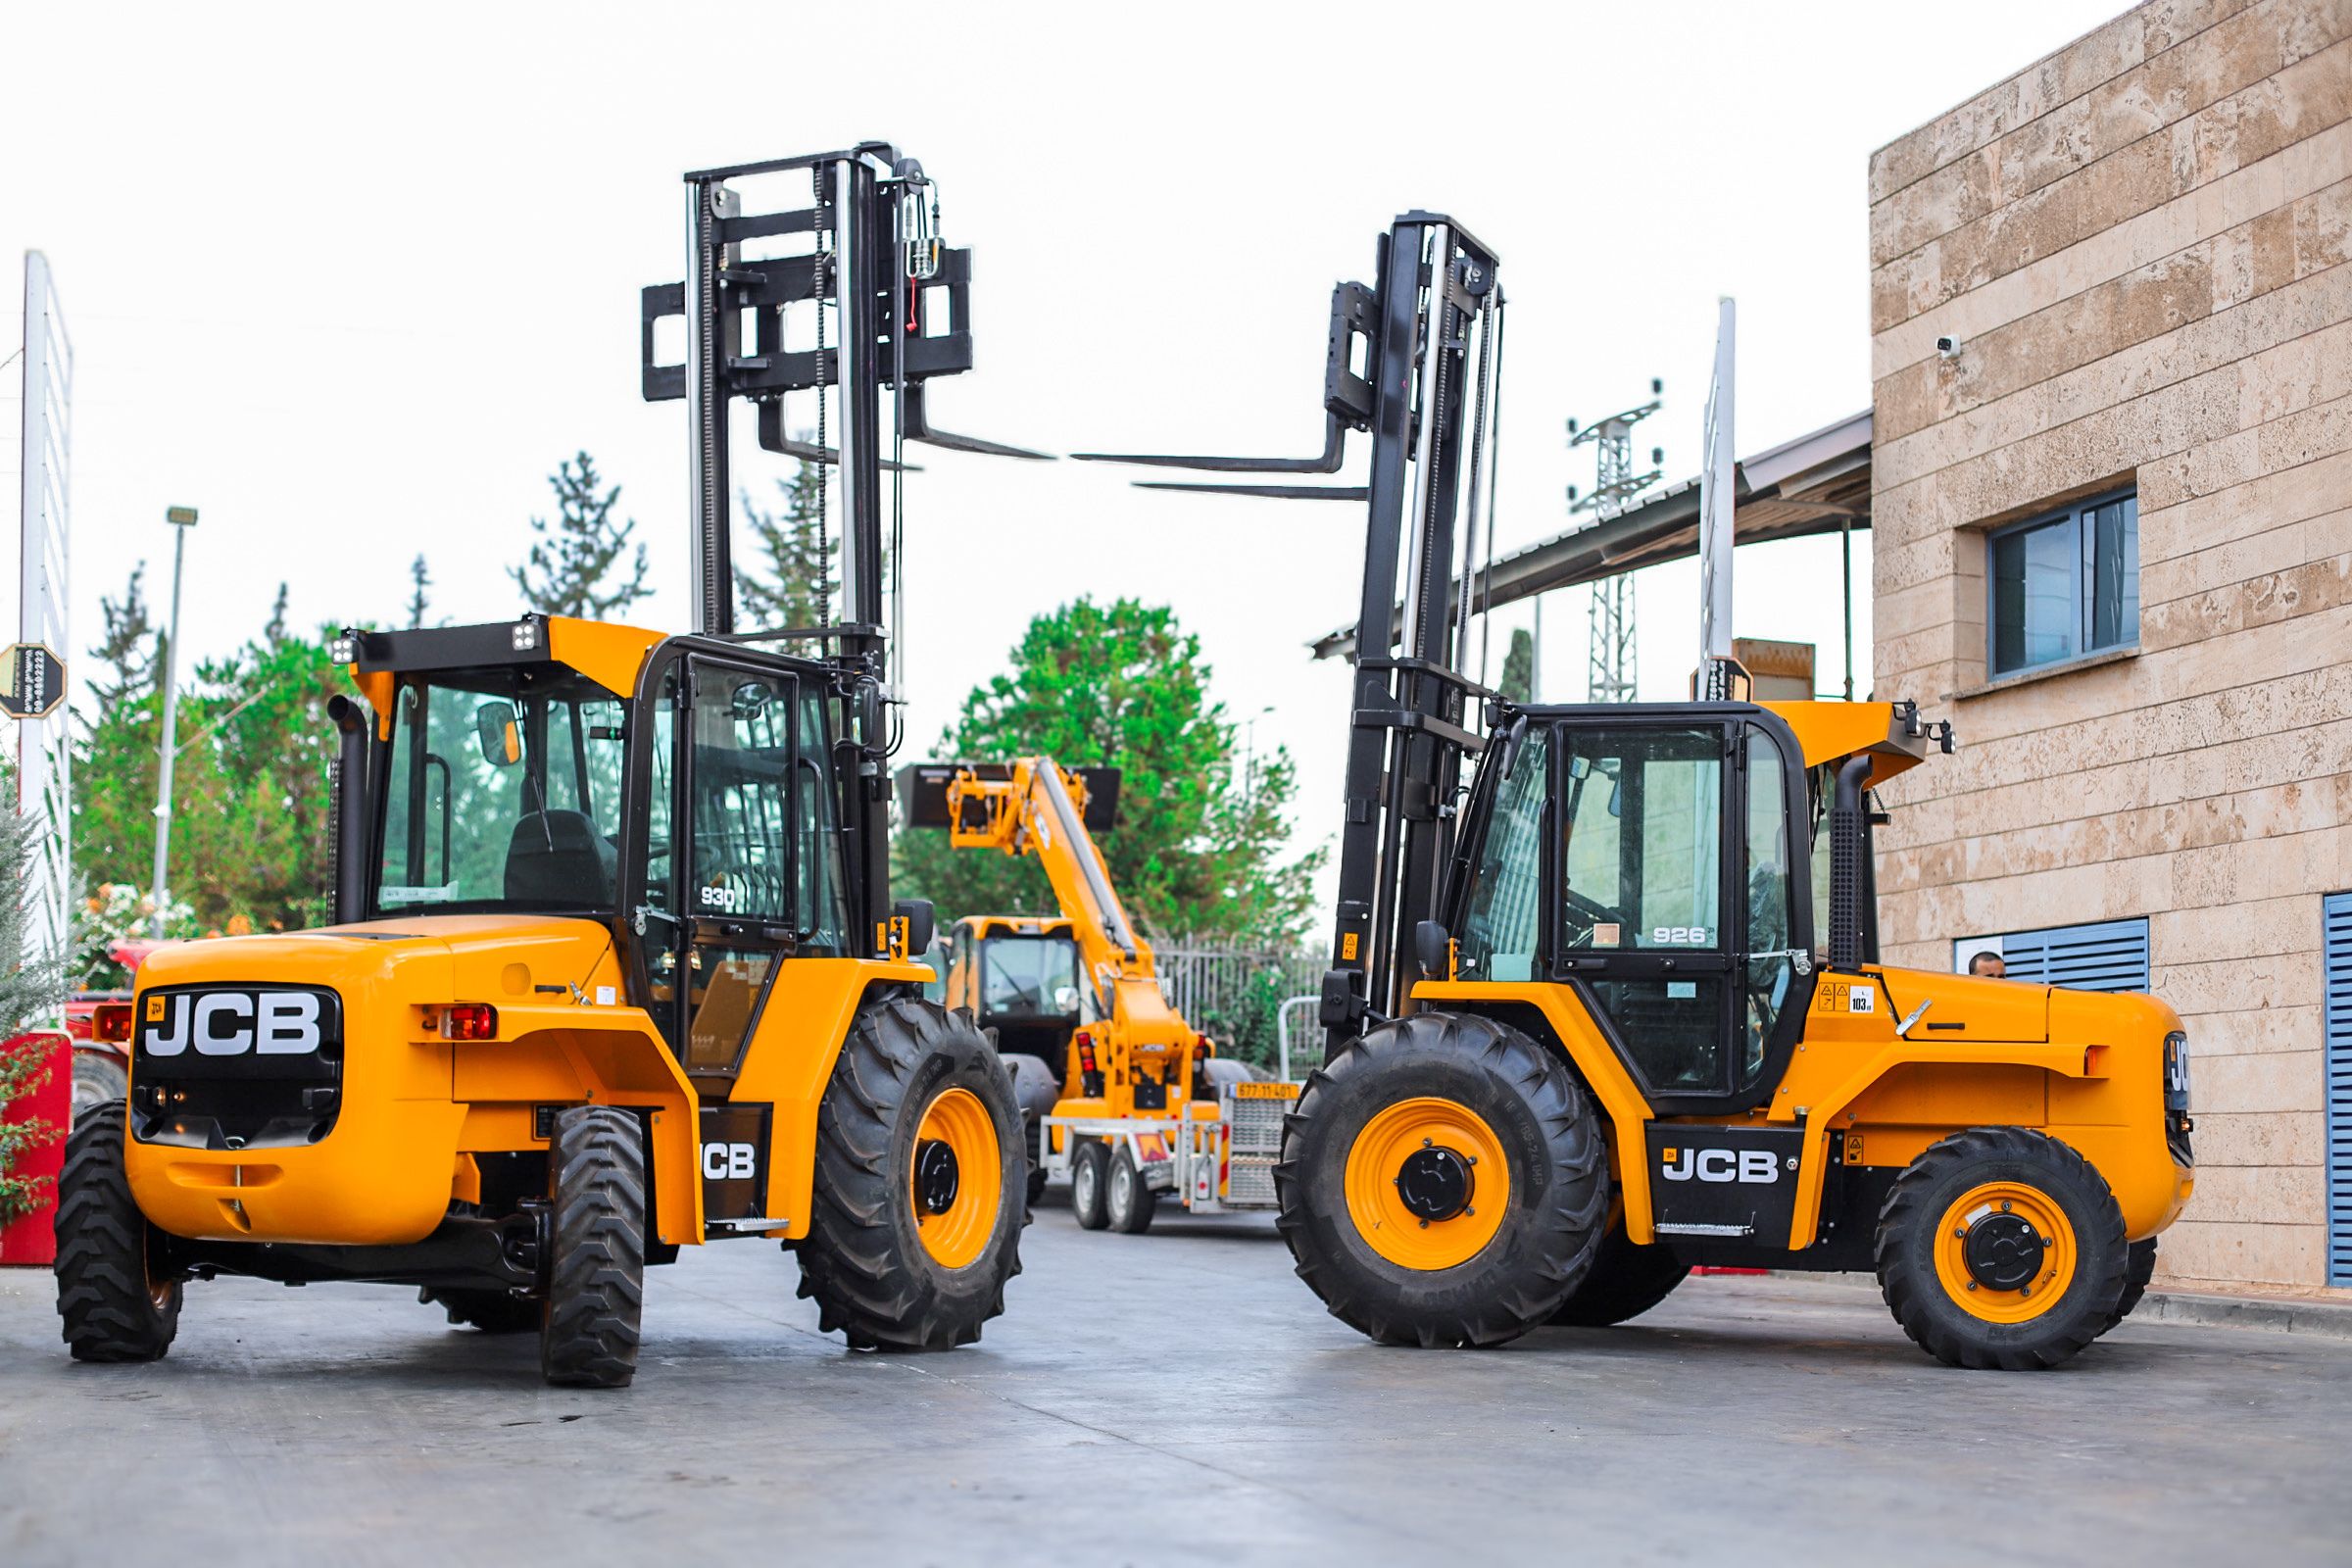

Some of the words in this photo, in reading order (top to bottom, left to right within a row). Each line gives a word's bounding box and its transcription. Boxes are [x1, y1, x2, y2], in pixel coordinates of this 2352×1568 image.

[701, 886, 735, 906] 930
[1653, 926, 1705, 944] 926
[1852, 998, 1866, 1011] 103
[145, 992, 320, 1056] JCB
[699, 1142, 756, 1180] CB
[1662, 1148, 1779, 1184] JCB
